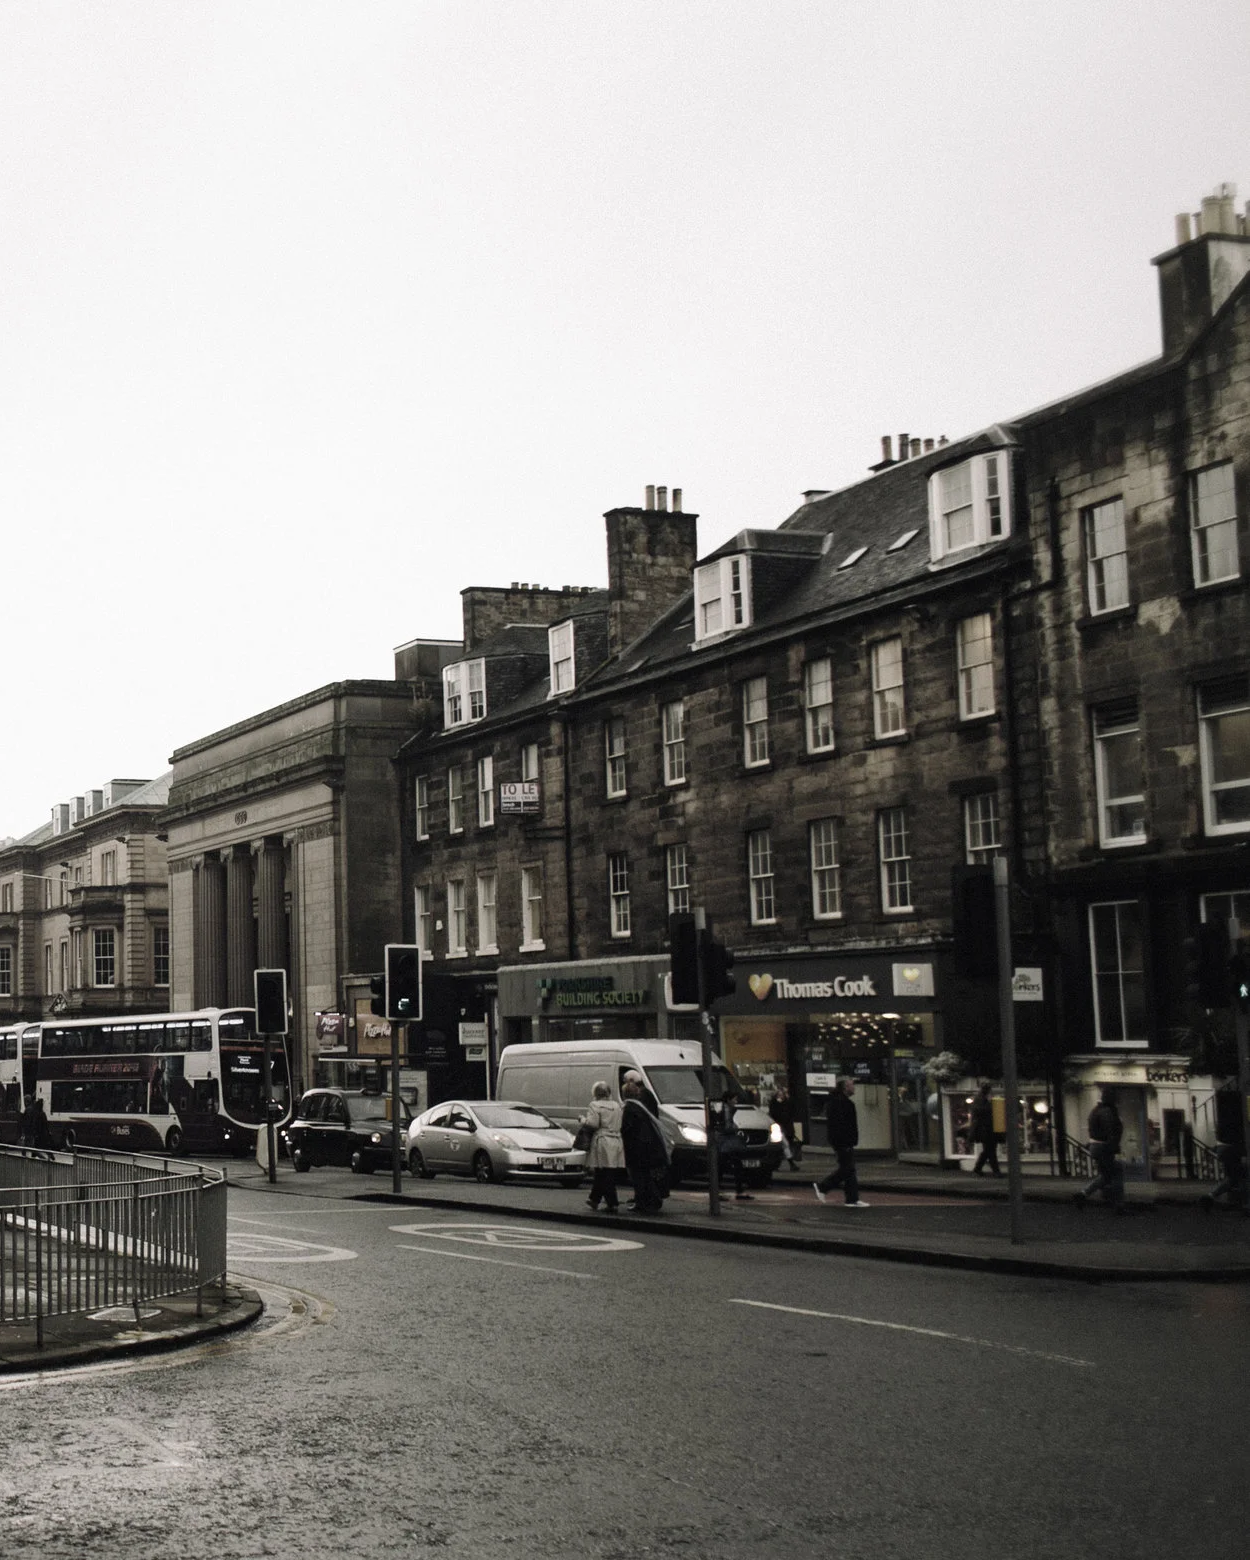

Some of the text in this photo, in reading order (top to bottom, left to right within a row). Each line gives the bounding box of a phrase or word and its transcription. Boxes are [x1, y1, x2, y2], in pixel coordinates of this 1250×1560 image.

[502, 784, 517, 795] TO
[773, 975, 876, 999] Thomas Cook
[556, 990, 644, 1006] BUILDING SOCIETY
[381, 1022, 391, 1036] Hu
